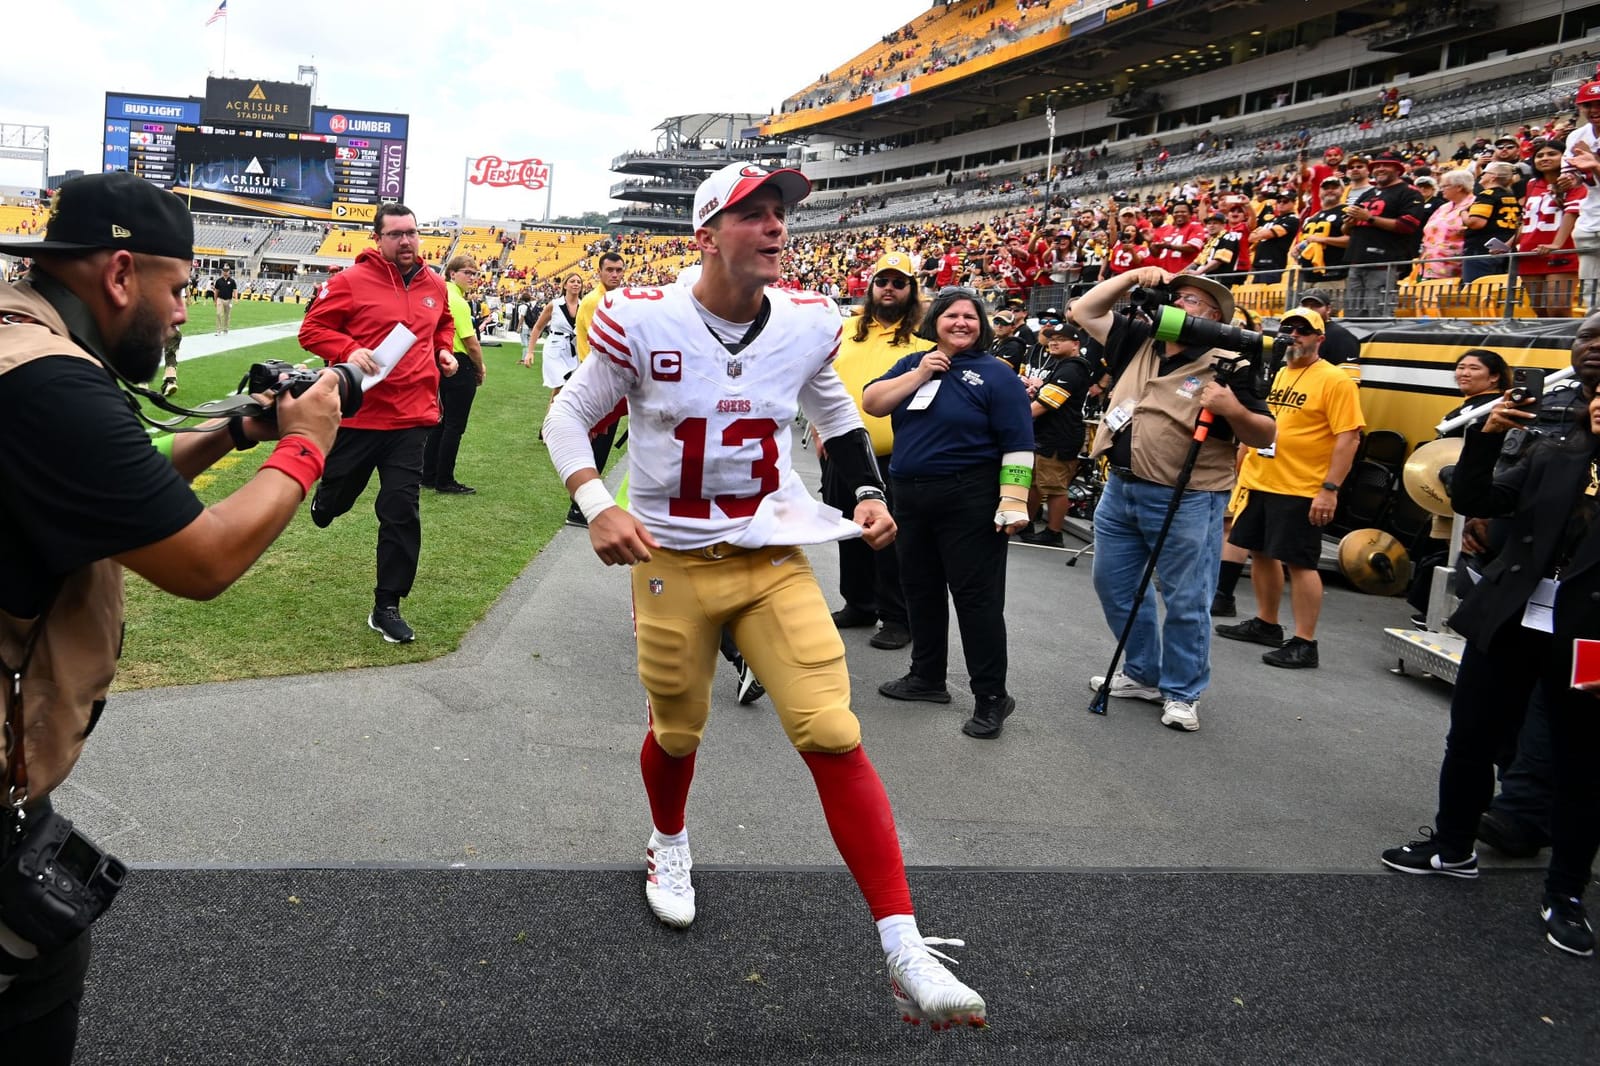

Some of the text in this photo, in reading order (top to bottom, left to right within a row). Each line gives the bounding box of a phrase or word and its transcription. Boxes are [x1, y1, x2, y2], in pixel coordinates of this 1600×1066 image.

[124, 103, 182, 117] BUD LIGHT
[225, 101, 288, 114] ACRISURE
[236, 111, 274, 120] STADIUM
[114, 126, 129, 134] PNC
[331, 118, 391, 133] 84 LUMBER
[386, 145, 402, 193] UPMC
[222, 174, 287, 187] ACRISURE
[234, 185, 272, 195] STADIUM
[349, 206, 373, 217] PNC
[652, 352, 680, 374] C
[716, 399, 752, 413] 49ERS
[668, 417, 780, 519] 13
